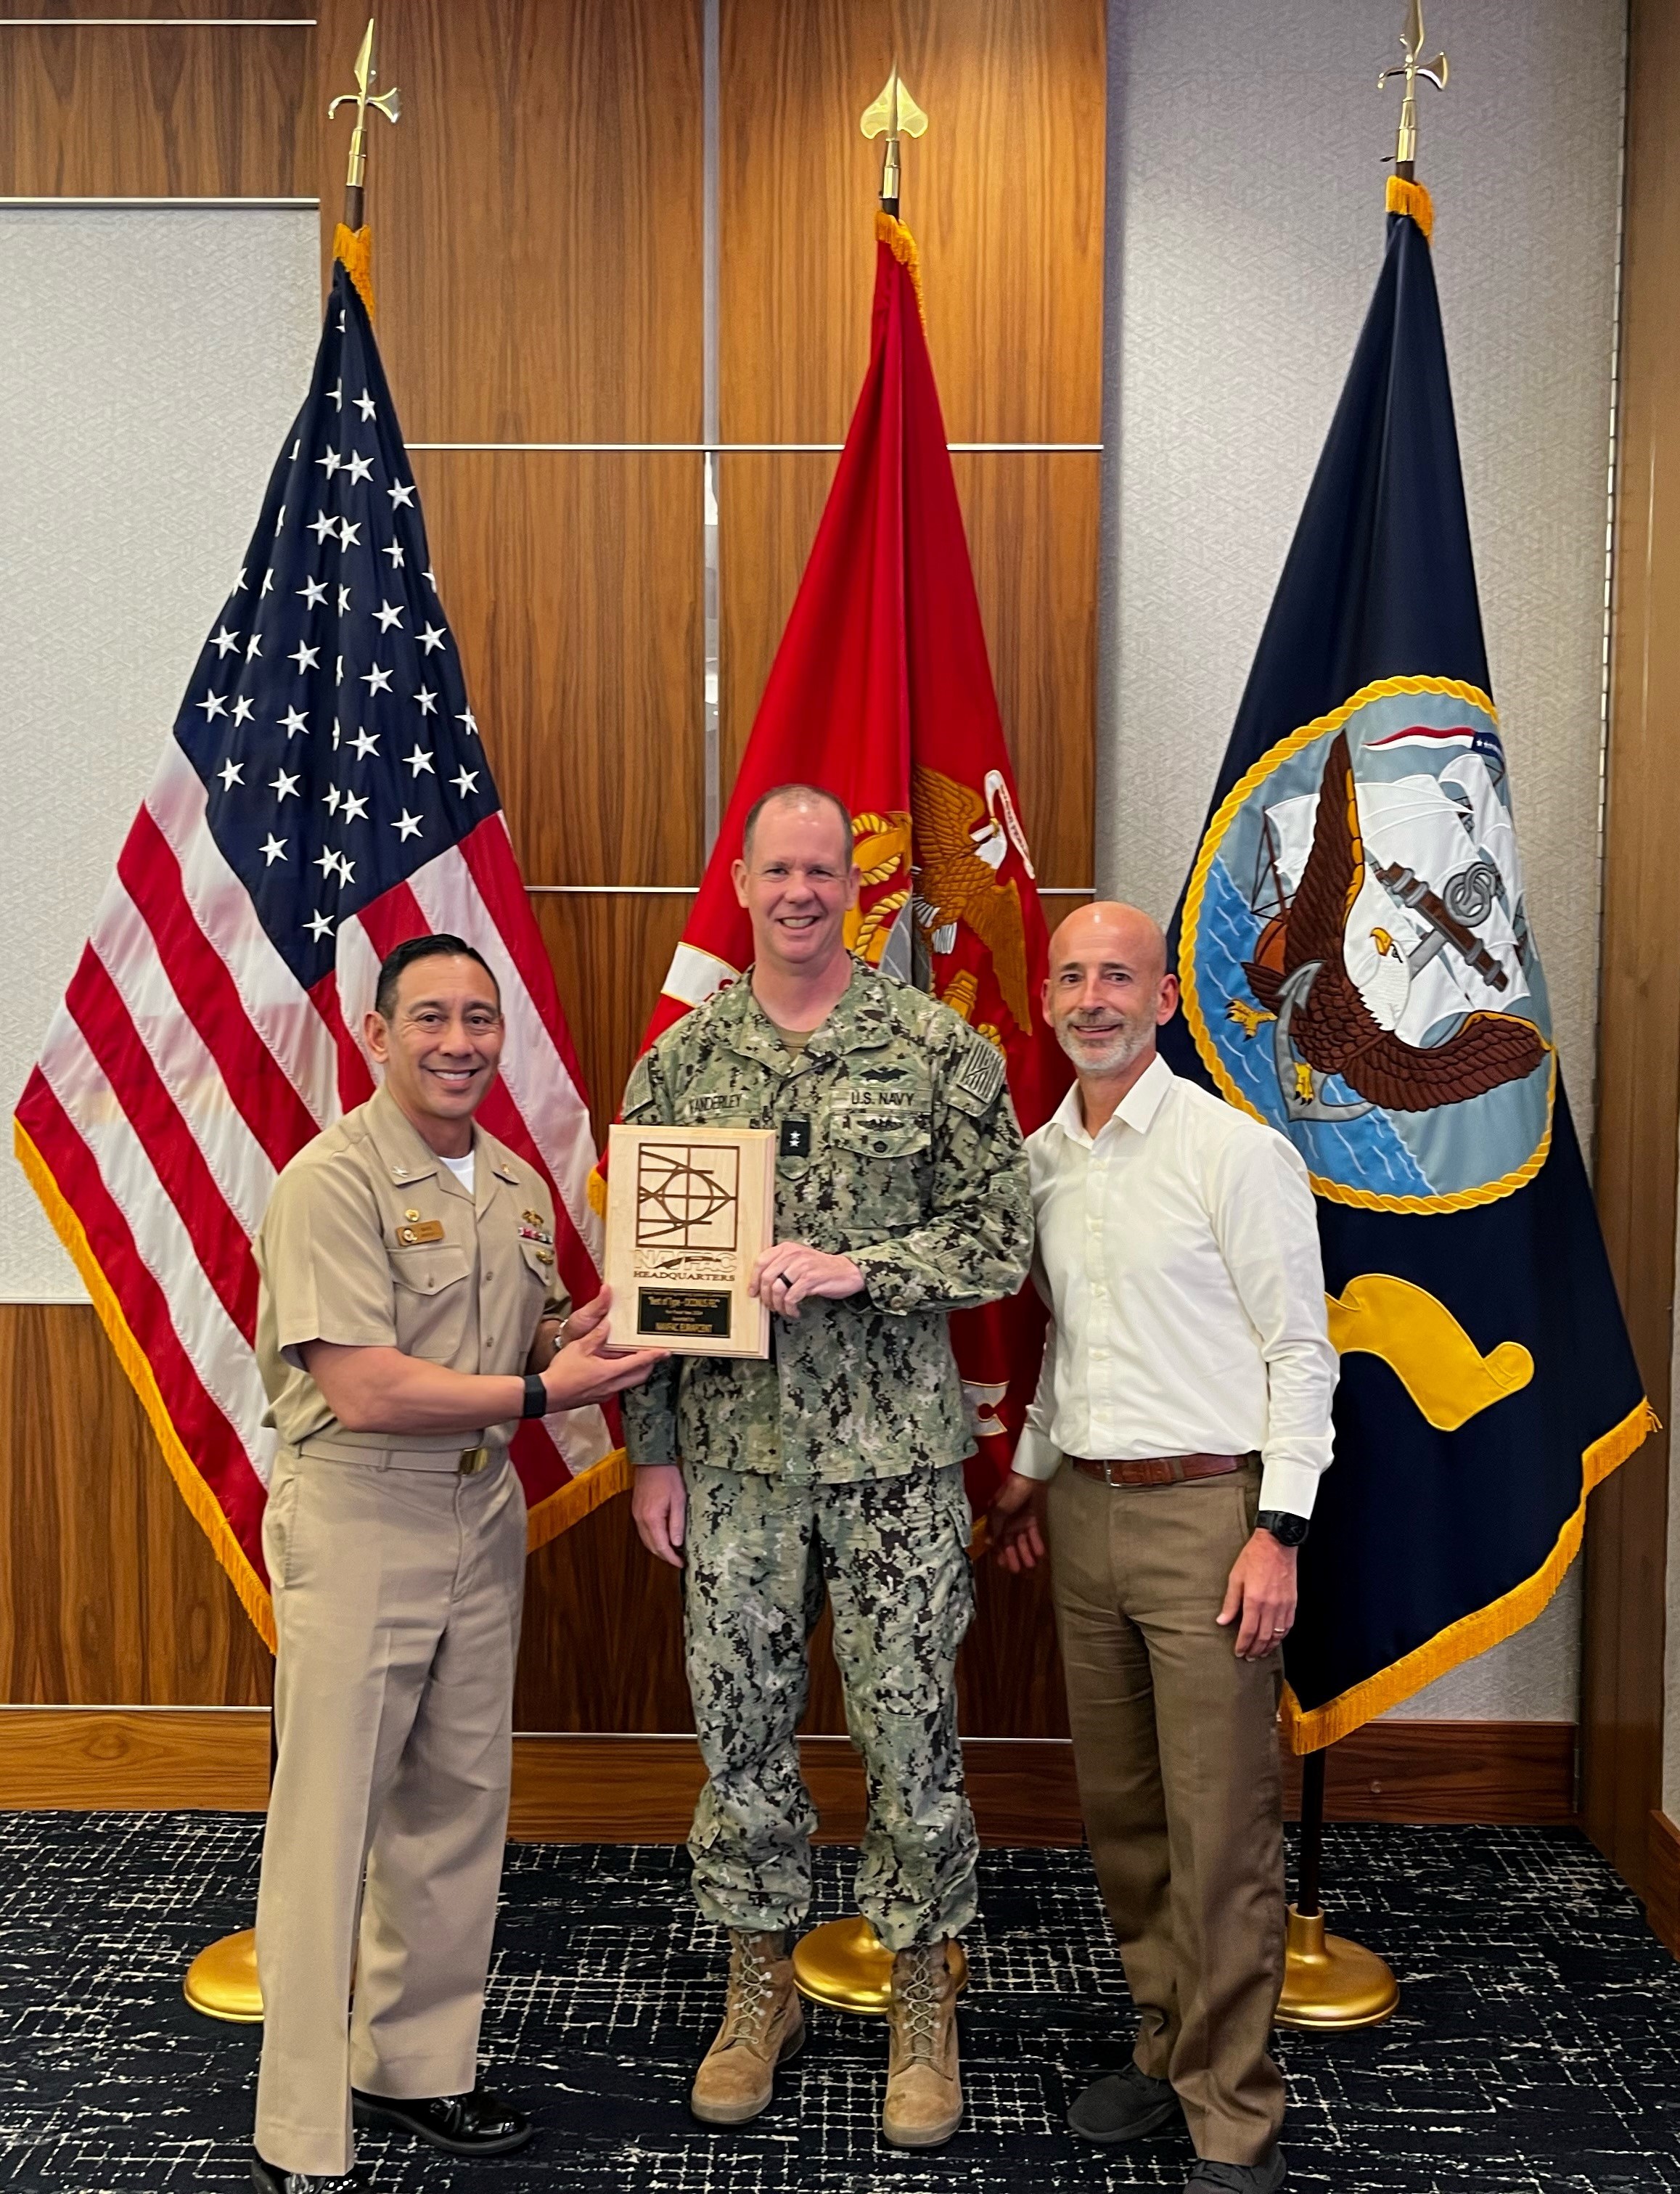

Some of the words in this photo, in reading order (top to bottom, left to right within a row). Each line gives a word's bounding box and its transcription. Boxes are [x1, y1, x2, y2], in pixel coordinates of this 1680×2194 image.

[851, 1092, 875, 1105] U.S.
[879, 1092, 914, 1106] NAVY
[634, 1249, 737, 1272] NAVFAC
[633, 1270, 736, 1281] HEADQUARTERS
